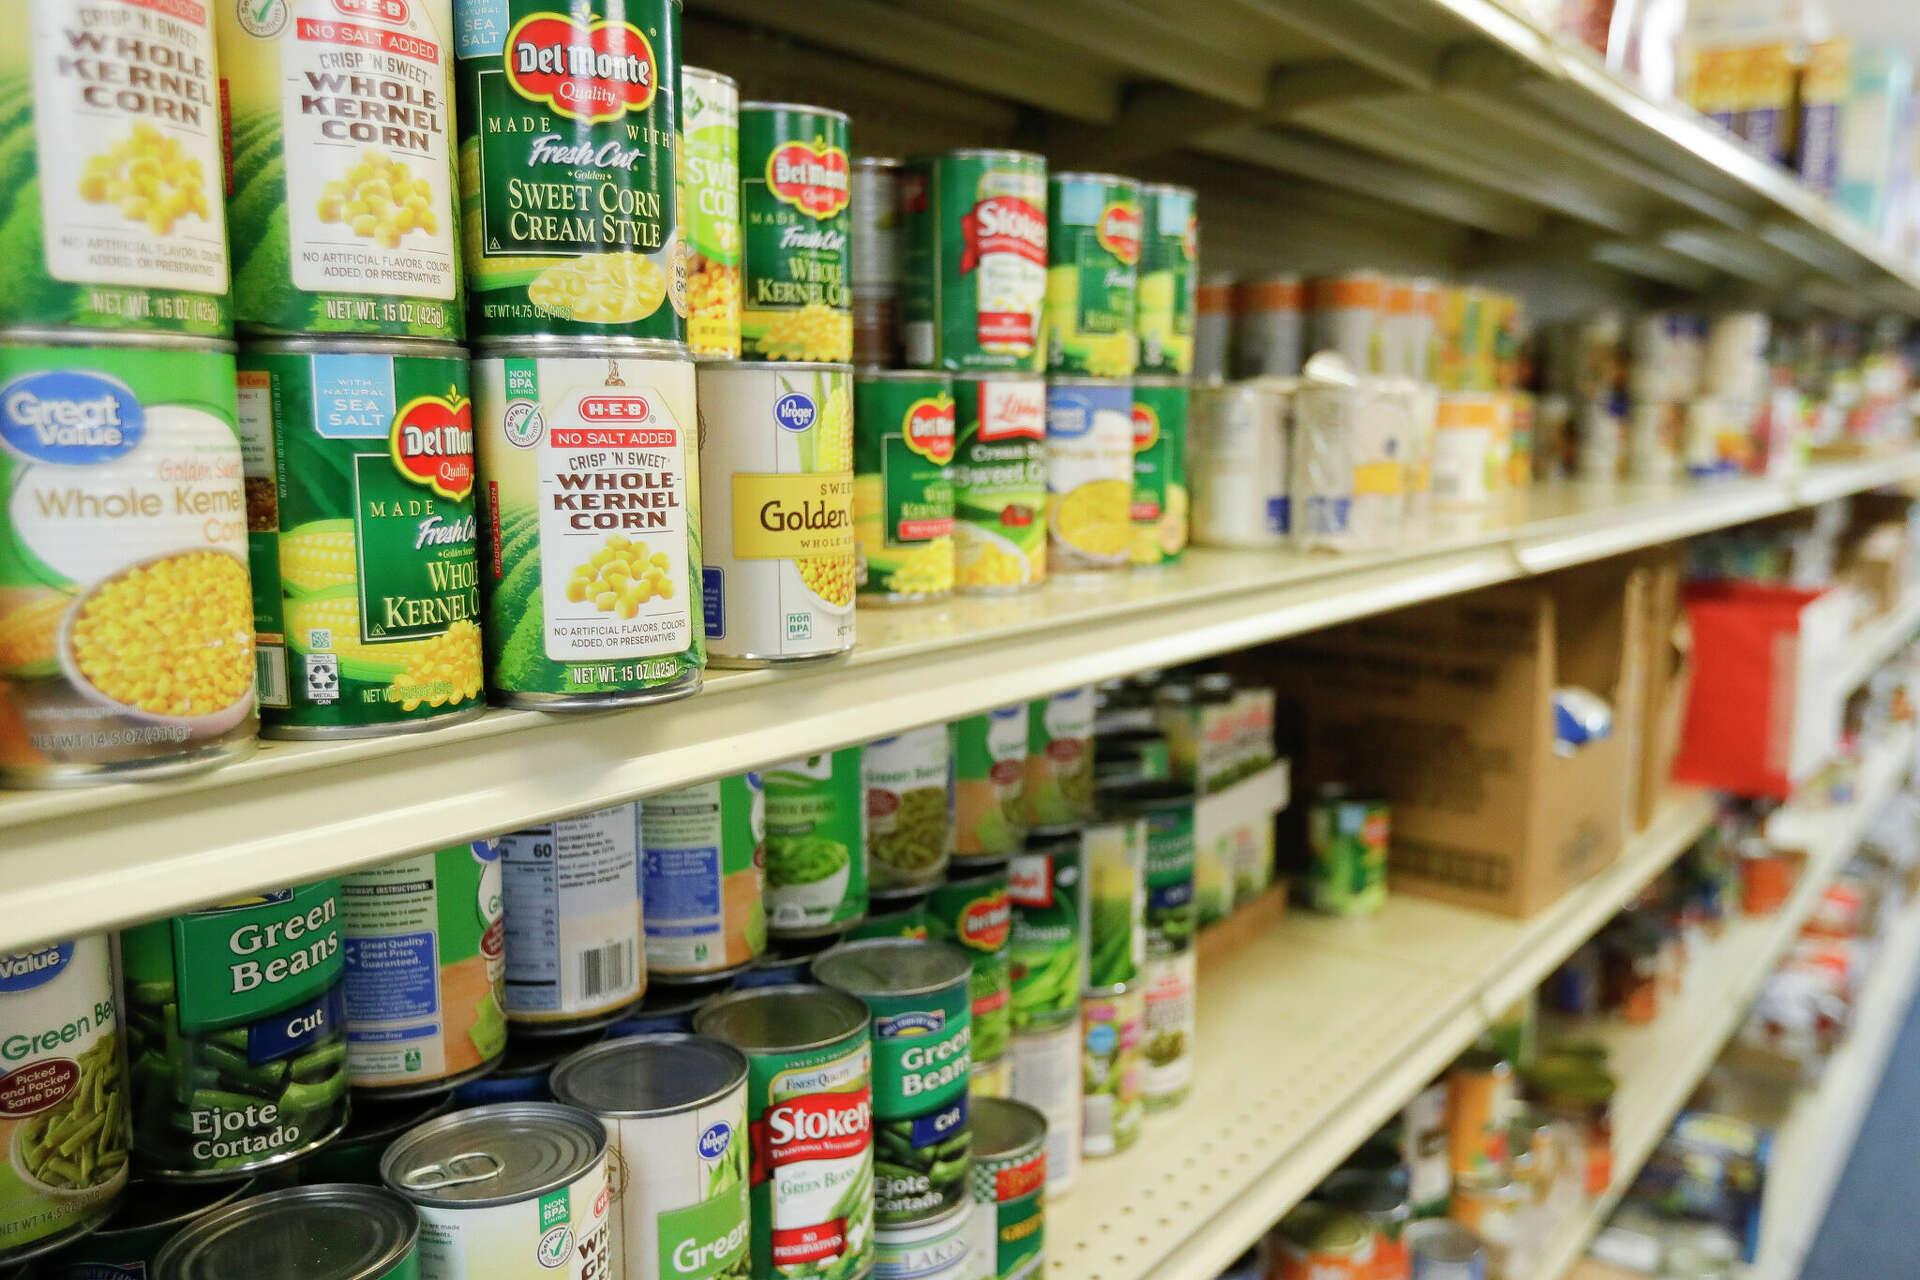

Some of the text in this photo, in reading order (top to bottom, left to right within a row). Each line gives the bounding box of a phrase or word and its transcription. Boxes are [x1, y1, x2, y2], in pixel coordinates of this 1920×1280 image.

[464, 18, 495, 32] SEA
[306, 24, 435, 60] NO SALT ADDED
[462, 31, 500, 47] SALT
[63, 27, 206, 79] WHOLE
[517, 42, 650, 86] Del Monte
[57, 54, 212, 107] KERNEL
[319, 53, 363, 70] CRISP
[387, 57, 428, 84] SWEET
[304, 71, 437, 109] WHOLE
[559, 81, 616, 107] Quality
[83, 85, 200, 126] CORN
[301, 94, 443, 135] KERNEL
[322, 120, 430, 152] CORN
[489, 117, 551, 134] MADE
[626, 125, 671, 148] WITH
[528, 134, 647, 170] Fresh Cut
[574, 169, 606, 181] Golden
[509, 178, 661, 220] SWEET CORN
[510, 211, 661, 249] CREAM STYLE
[303, 252, 319, 263] NO
[323, 252, 379, 266] ARTIFICIAL
[365, 268, 379, 280] OR
[381, 270, 441, 285] PRESERVATIVES
[756, 278, 825, 305] KERNEL
[327, 300, 444, 328] NET WT. 15 OZ (425g)
[498, 304, 511, 318] WT
[511, 304, 532, 318] 14.75
[534, 304, 546, 318] OZ
[337, 378, 372, 386] WITH
[509, 370, 535, 379] NON-
[509, 378, 534, 390] BPA
[6, 391, 122, 426] Great
[334, 399, 380, 412] SEA
[780, 399, 813, 427] Kroger
[329, 413, 385, 427] SALT
[37, 424, 123, 446] Value
[402, 425, 443, 457] Del
[557, 432, 674, 445] NO SALT ADDED
[158, 458, 212, 482] Golden
[440, 462, 471, 482] Quality
[568, 452, 607, 471] CRISP
[628, 451, 668, 470] SWEET
[556, 471, 675, 492] WHOLE
[34, 486, 242, 518] Whole Kerne
[491, 487, 498, 505] NO
[553, 491, 680, 511] KERNEL
[370, 500, 435, 518] MADE
[570, 511, 667, 530] CORN
[760, 500, 849, 532] Golden
[415, 515, 464, 550] Fresh
[800, 537, 841, 549] WHOLE
[383, 594, 470, 629] KERNEL
[789, 614, 810, 624] non
[554, 618, 686, 636] NO ARTIFICIAL FLAVORS, COLORS
[789, 623, 809, 633] BPA
[571, 633, 676, 649] ADDED, OR PRESERVATIVES
[573, 667, 595, 685] NET
[598, 666, 618, 684] WT.
[621, 665, 634, 683] 15
[636, 663, 650, 681] OZ
[533, 843, 553, 859] 60
[229, 895, 337, 956] Green
[360, 941, 387, 950] Great
[360, 948, 417, 960] Great Price.
[0, 950, 61, 980] Value
[230, 930, 339, 995] Beans
[361, 957, 422, 969] Guaranteed.
[286, 1008, 325, 1039] Cut
[1, 1014, 91, 1061] Green
[1, 1071, 71, 1101] and Packed
[15, 1064, 57, 1086] Picked
[8, 1083, 68, 1110] Same Day
[191, 1103, 279, 1140] Ejote
[933, 1107, 961, 1132] Cut
[192, 1126, 300, 1160] Cortado
[702, 1129, 730, 1152] Kroger
[544, 1206, 566, 1220] BPA
[774, 1234, 843, 1258] PRESERVATIVES
[803, 1232, 817, 1242] NO
